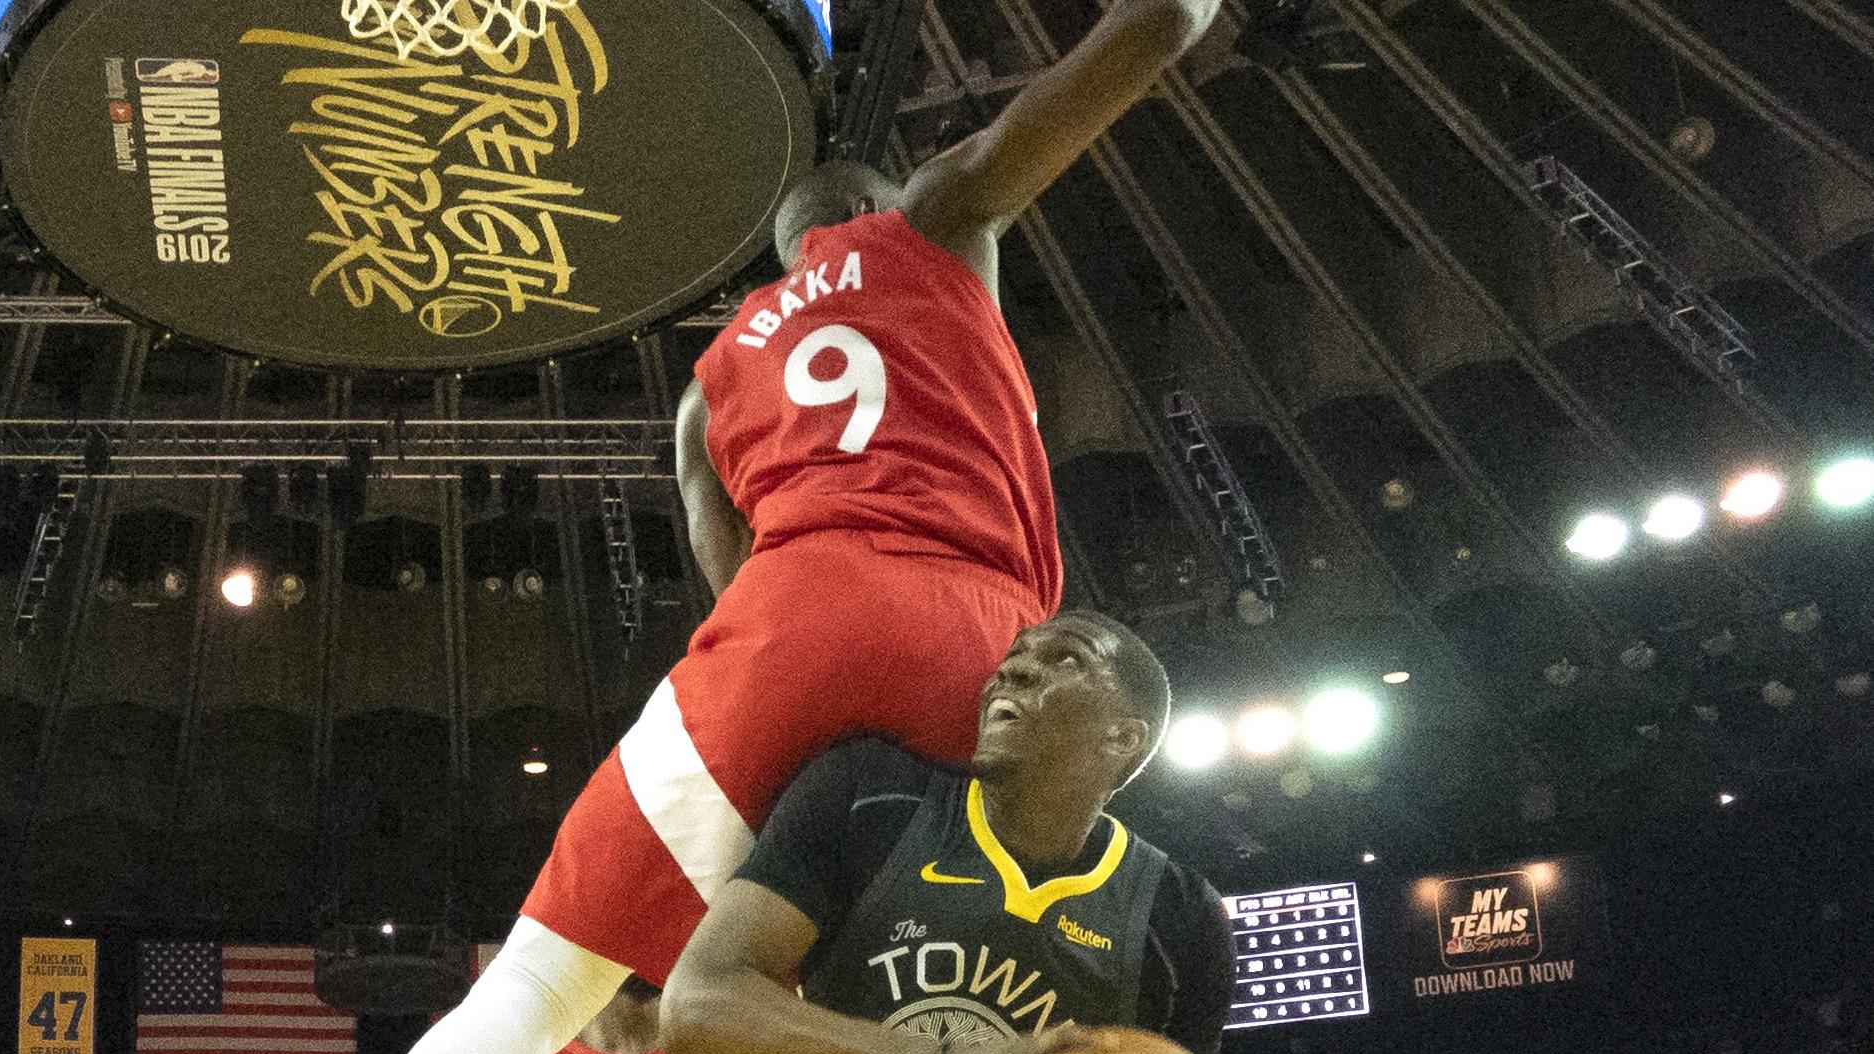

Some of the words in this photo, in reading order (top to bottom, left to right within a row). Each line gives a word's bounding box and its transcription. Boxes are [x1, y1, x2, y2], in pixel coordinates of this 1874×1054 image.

[139, 86, 222, 143] NBA
[146, 147, 229, 232] FINALS
[156, 233, 231, 264] 2019
[736, 251, 863, 349] IBAKA
[784, 323, 888, 454] 9
[1471, 887, 1508, 914] MY
[890, 919, 927, 942] The
[1057, 914, 1113, 951] Rakuten
[1450, 908, 1529, 938] TEAMS
[27, 965, 88, 976] CALIFORNIA
[1414, 966, 1524, 997] DOWNLOAD
[1528, 960, 1574, 984] NOW
[27, 992, 87, 1041] 47
